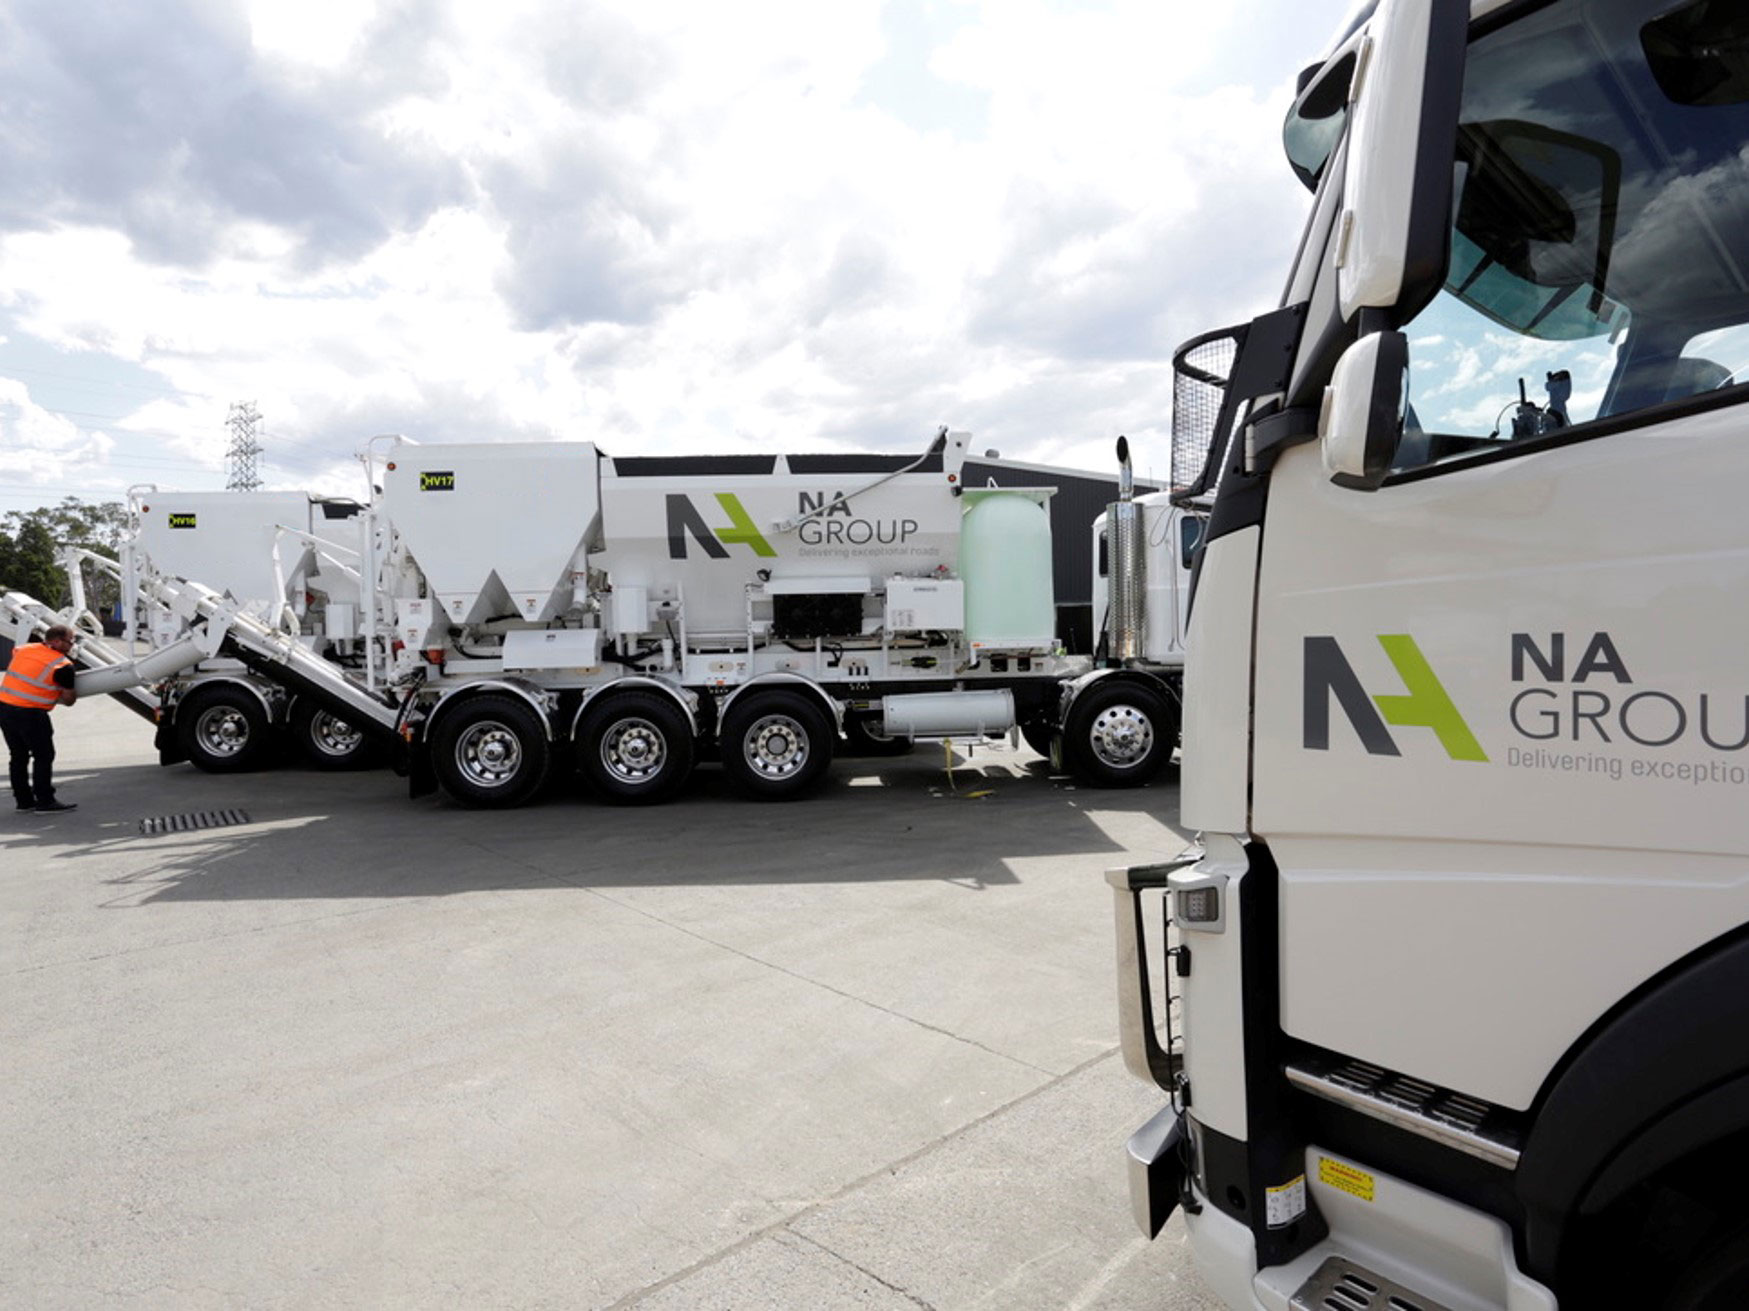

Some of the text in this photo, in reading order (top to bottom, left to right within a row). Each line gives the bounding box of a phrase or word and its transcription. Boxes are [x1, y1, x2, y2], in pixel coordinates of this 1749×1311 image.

[799, 491, 852, 517] NA
[799, 519, 919, 545] GROUP
[799, 548, 850, 558] Delivering
[851, 547, 908, 557] exceptional
[1511, 632, 1634, 684] NA
[1507, 747, 1749, 785] Delivering exceptio
